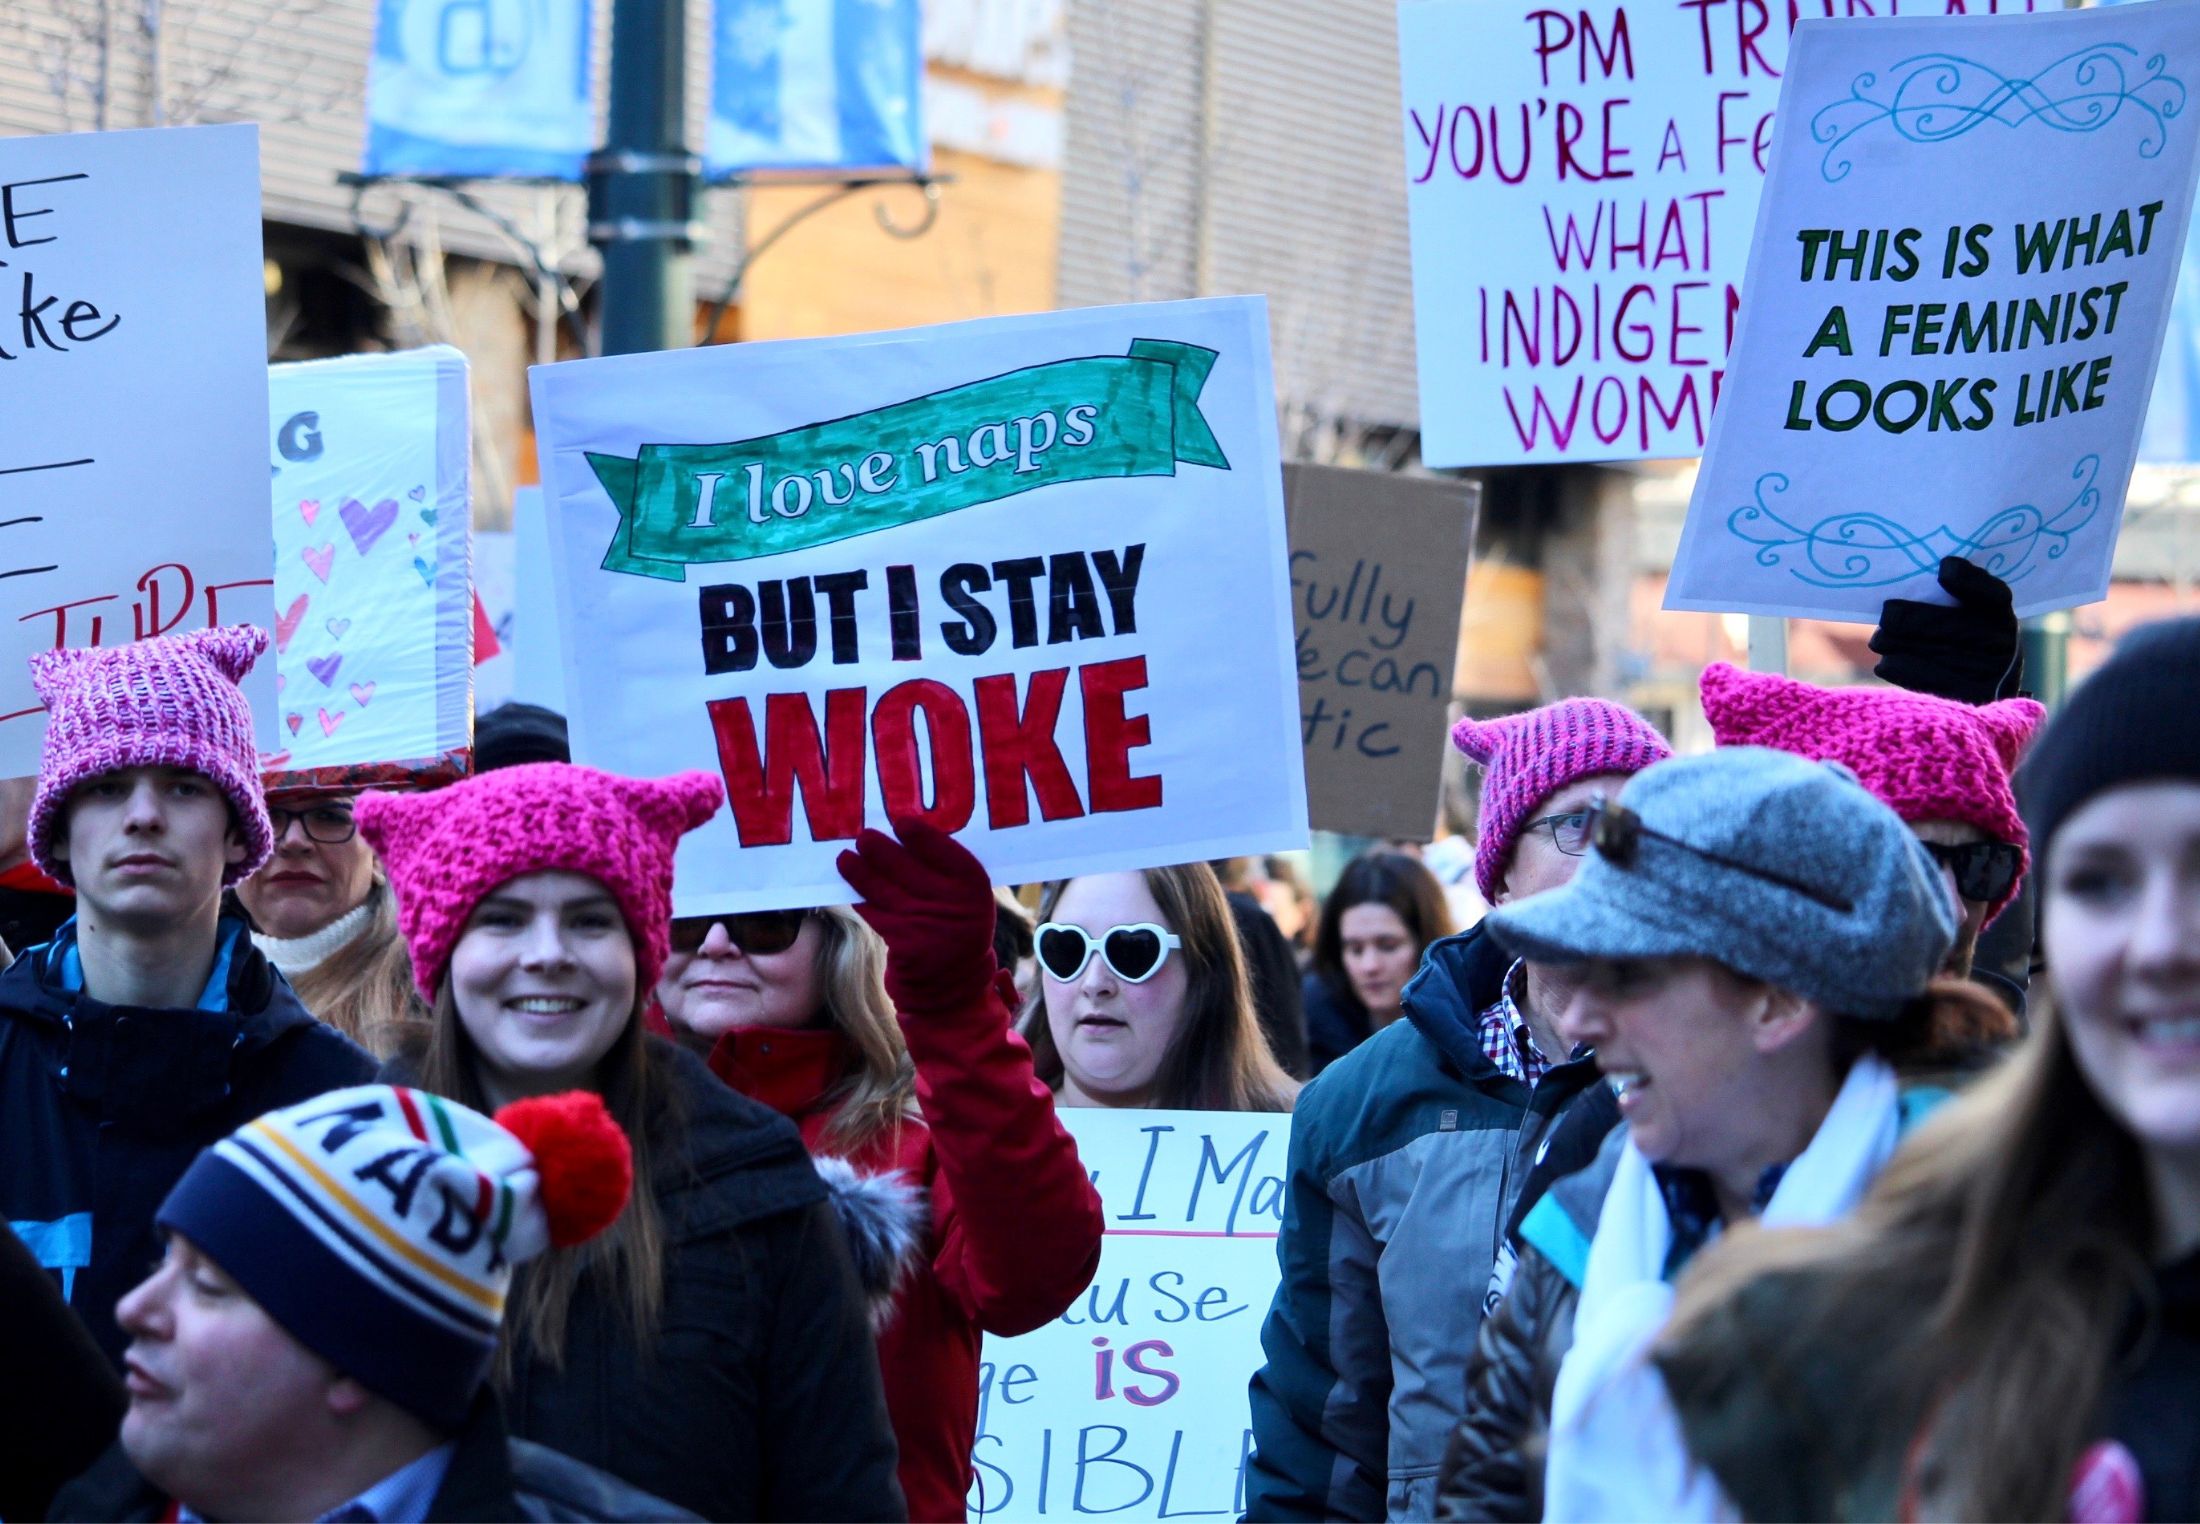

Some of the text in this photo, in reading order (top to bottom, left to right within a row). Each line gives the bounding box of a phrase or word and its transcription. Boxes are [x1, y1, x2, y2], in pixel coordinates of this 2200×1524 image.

[1525, 7, 1635, 87] PM
[1410, 99, 1635, 185] YOU'RE
[1657, 118, 1687, 173] A
[1542, 190, 1726, 272] WHAT
[1796, 200, 2164, 283] THIS IS WHAT
[0, 270, 122, 361] ke
[1802, 281, 2129, 359] A FEMINIST
[1503, 370, 1725, 452] WOM
[1783, 355, 2113, 435] LOOKS LIKE
[687, 403, 1098, 528] I love naps
[699, 542, 1146, 676] BUT I STAY
[705, 655, 1164, 849] WOKE
[1117, 1126, 1174, 1220] I
[1060, 1271, 1249, 1325] use
